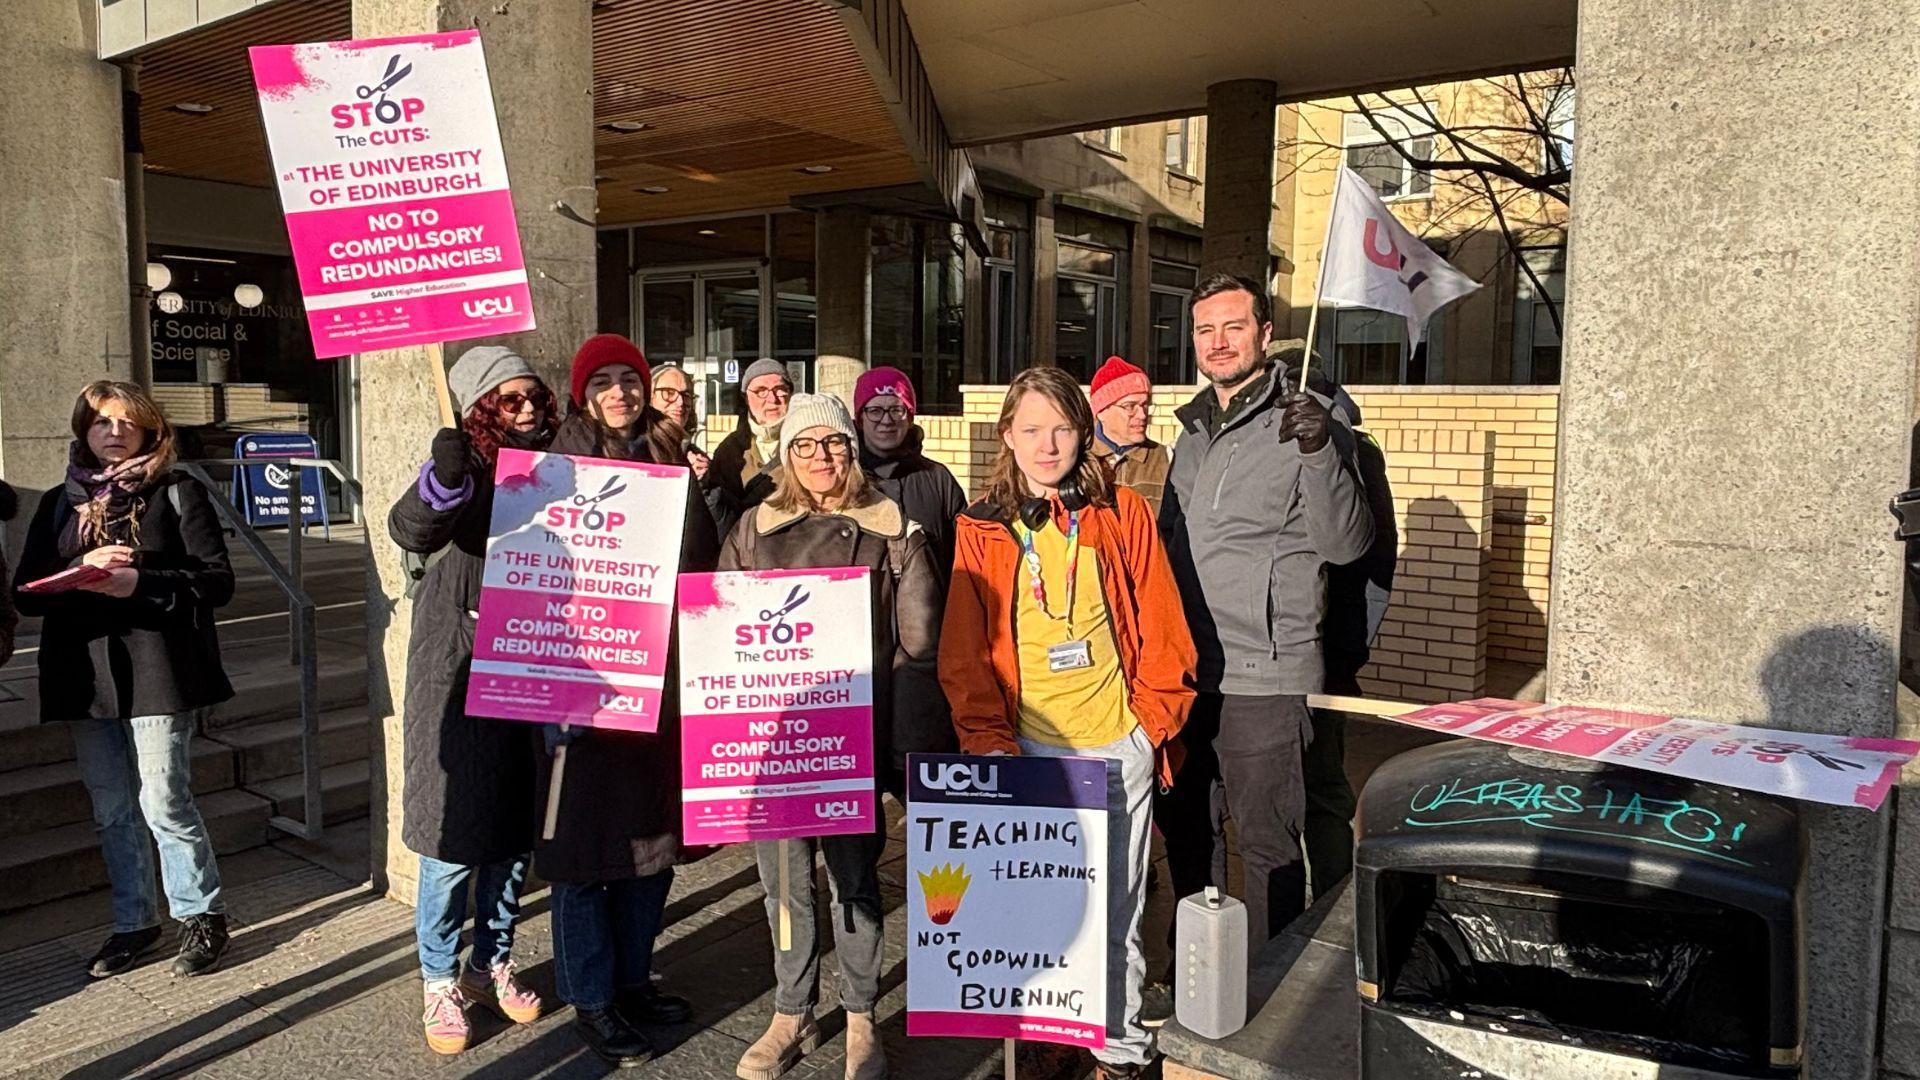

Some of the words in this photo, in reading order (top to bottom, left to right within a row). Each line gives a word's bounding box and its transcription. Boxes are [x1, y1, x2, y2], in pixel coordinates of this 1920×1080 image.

[331, 96, 425, 129] STOP
[336, 135, 367, 148] The
[369, 127, 430, 146] CUTS:
[284, 172, 295, 181] at
[296, 163, 345, 183] THE
[349, 149, 482, 178] UNIVERSITY
[310, 187, 342, 205] OF
[346, 172, 482, 201] EDINBURGH
[368, 212, 403, 232] NO
[407, 208, 439, 227] TO
[329, 225, 484, 259] COMPULSORY
[320, 246, 502, 284] REDUNDANCIES!
[371, 290, 394, 299] SAVE
[396, 287, 423, 295] Higher
[425, 282, 466, 292] Education
[165, 320, 226, 340] Social
[234, 323, 248, 341] &
[255, 496, 270, 505] No
[272, 495, 315, 505] smng
[271, 506, 289, 515] this
[546, 504, 625, 532] STOP
[544, 531, 569, 544] The
[572, 533, 622, 549] CUTS:
[504, 551, 541, 567] THE
[547, 555, 660, 579] UNIVERSITY
[506, 571, 533, 586] OF
[538, 573, 652, 598] EDINBURGH
[546, 601, 575, 619] NO
[578, 605, 606, 621] TO
[506, 619, 641, 645] COMPULSORY
[735, 620, 814, 646] STOP
[492, 637, 648, 666] REDUNDANCIES!
[735, 651, 760, 663] The
[763, 648, 814, 662] CUTS:
[698, 675, 736, 691] THE
[742, 669, 855, 689] UNIVERSITY
[705, 695, 731, 710] OF
[737, 689, 850, 709] EDINBURGH
[748, 721, 778, 737] NO
[783, 719, 809, 735] TO
[711, 736, 845, 758] COMPULSORY
[702, 755, 856, 778] REDUNDANCIES!
[916, 817, 1078, 852] TEACHING
[917, 931, 962, 947] NOT
[947, 949, 1068, 977] GOODWILL
[961, 983, 1085, 1017] BURNING
[1019, 1023, 1096, 1040] www.ucu.org.uk
